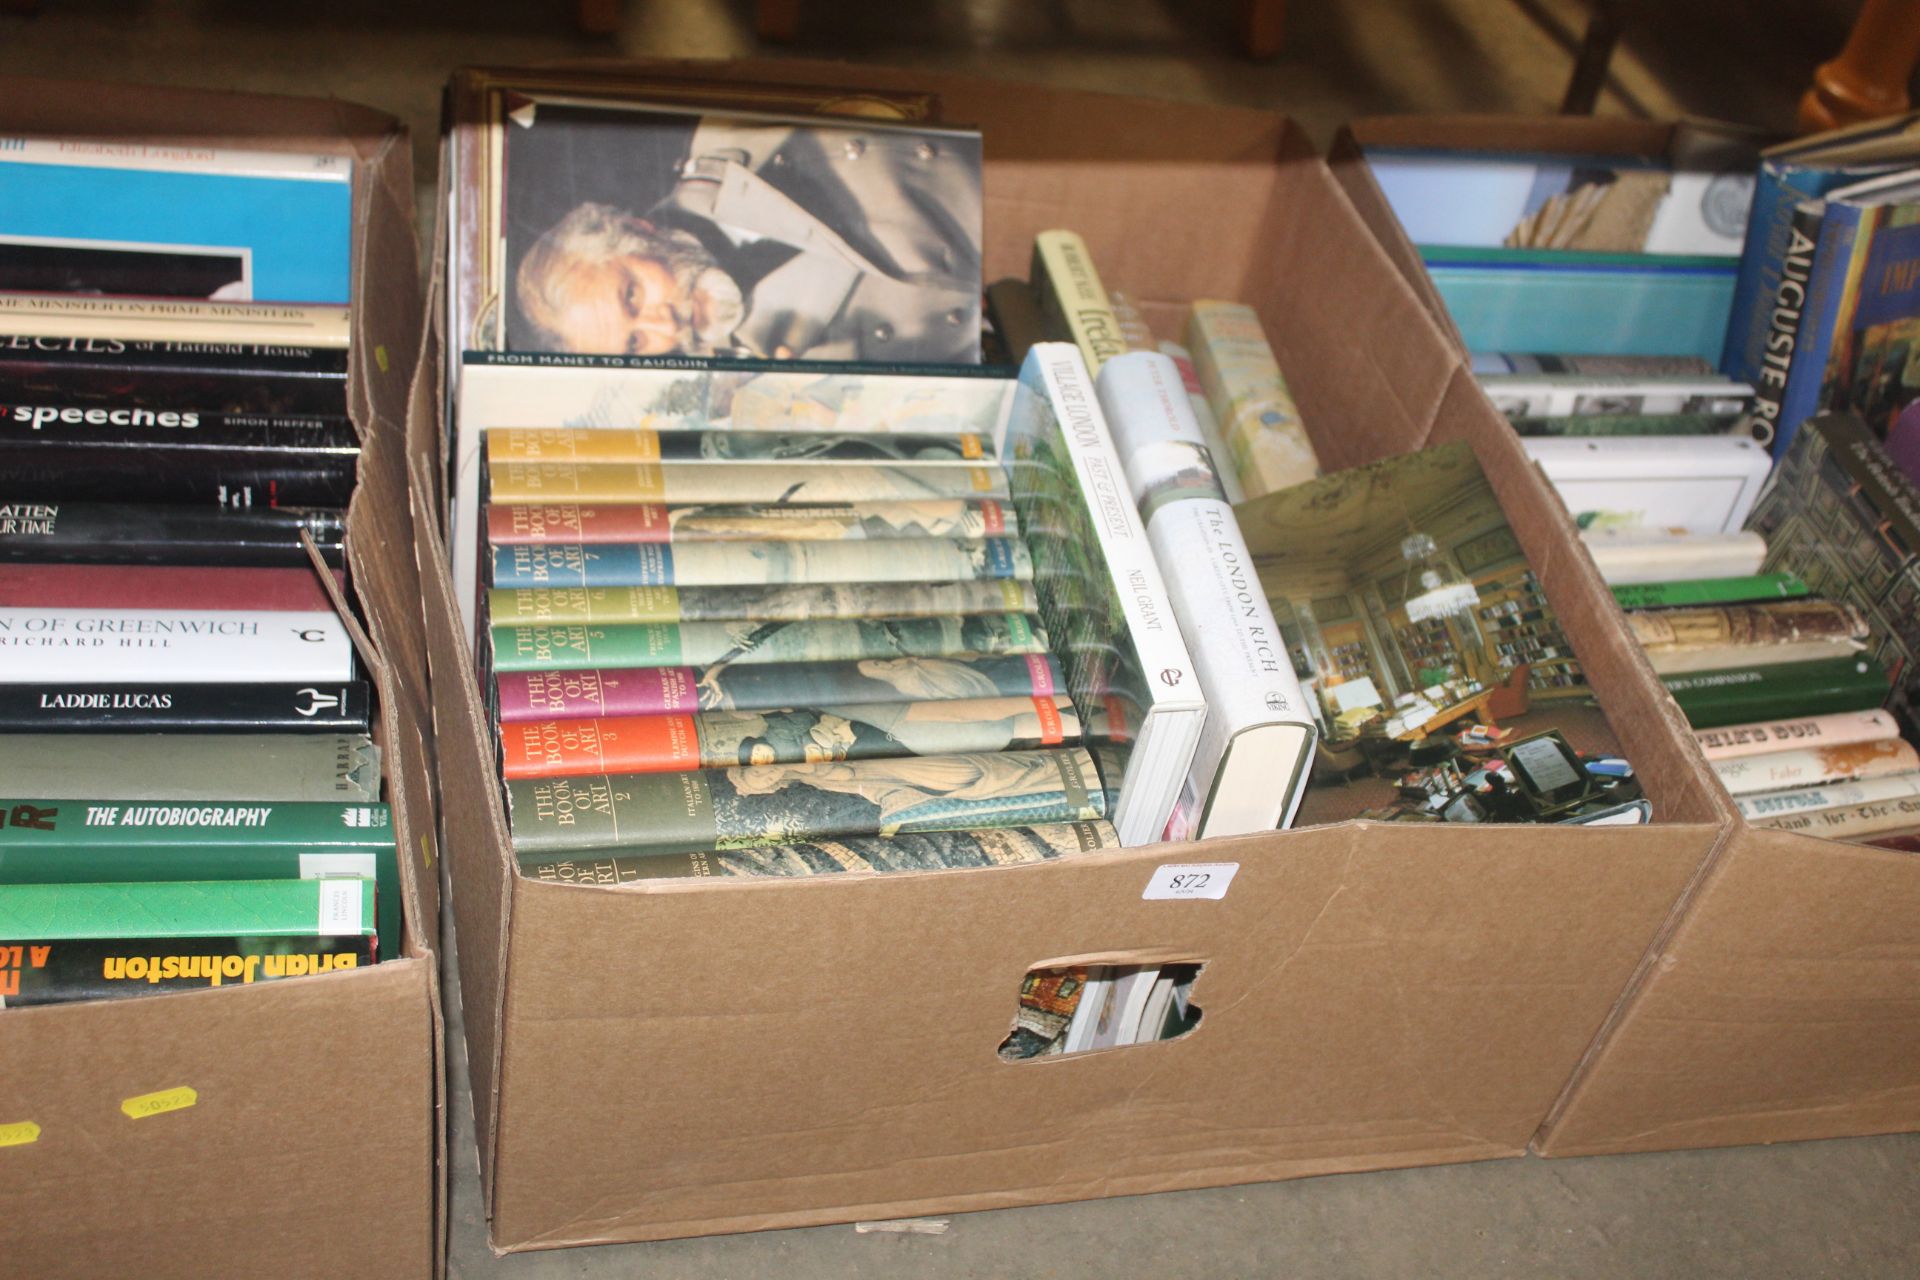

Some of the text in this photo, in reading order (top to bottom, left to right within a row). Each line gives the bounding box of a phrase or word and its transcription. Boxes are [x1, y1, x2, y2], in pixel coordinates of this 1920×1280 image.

[31, 299, 113, 311] MINISTER
[118, 302, 146, 312] ON
[151, 304, 200, 315] PRIME
[211, 306, 305, 319] MINISTERS
[1759, 227, 1815, 388] AUGUSTE
[1078, 310, 1121, 362] Irela
[253, 346, 313, 358] House
[487, 354, 533, 364] FROM
[539, 355, 595, 366] MANET
[602, 357, 624, 367] TO
[630, 358, 709, 369] GAUGUIN
[1051, 360, 1086, 402] VILLAGE
[14, 407, 199, 429] speeches
[224, 417, 323, 428] SIMON HEFFER
[1066, 403, 1102, 448] LONDON
[20, 520, 55, 534] TIME
[546, 508, 560, 525] OF
[1101, 495, 1128, 539] PRESENT
[533, 545, 549, 581] BOO
[548, 548, 563, 568] OF
[564, 545, 581, 573] ART
[591, 592, 605, 600] 6
[1127, 568, 1162, 632] NEIL GRANT
[1206, 507, 1279, 674] The LONDON RICH
[26, 618, 65, 631] OF
[75, 619, 259, 635] GREENWICH
[551, 628, 568, 646] OF
[567, 626, 585, 652] ART
[0, 637, 171, 648] RICHARD HILL
[534, 626, 551, 660] BOO
[528, 674, 545, 708] THE
[545, 671, 565, 712] BOOK
[565, 678, 582, 698] OF
[581, 673, 599, 702] ART
[605, 680, 619, 688] 4
[660, 683, 671, 709] GERMAN
[669, 683, 680, 709] SPANISH
[678, 684, 687, 696] TO
[41, 694, 171, 708] LADDIE LUCAS
[524, 726, 542, 760] THE
[542, 721, 563, 765] BOOK
[562, 730, 579, 750] OF
[579, 725, 599, 756] ART
[669, 731, 682, 759] FLEMISH
[679, 730, 689, 756] DUTCH
[1061, 753, 1081, 789] GROLIER
[534, 784, 555, 821] THE
[555, 780, 576, 825] BOOK
[574, 789, 591, 810] OF
[590, 783, 611, 814] ART
[616, 791, 631, 800] 2
[681, 773, 696, 816] ITALIAN ART
[693, 793, 703, 805] TO
[85, 807, 272, 826] THE AUTOBIOGRAPHY
[1857, 804, 1890, 820] The
[1081, 822, 1098, 851] ROLIER
[596, 863, 614, 883] RT
[1169, 873, 1211, 889] 872
[30, 946, 51, 968] A
[104, 955, 259, 986] Johnston
